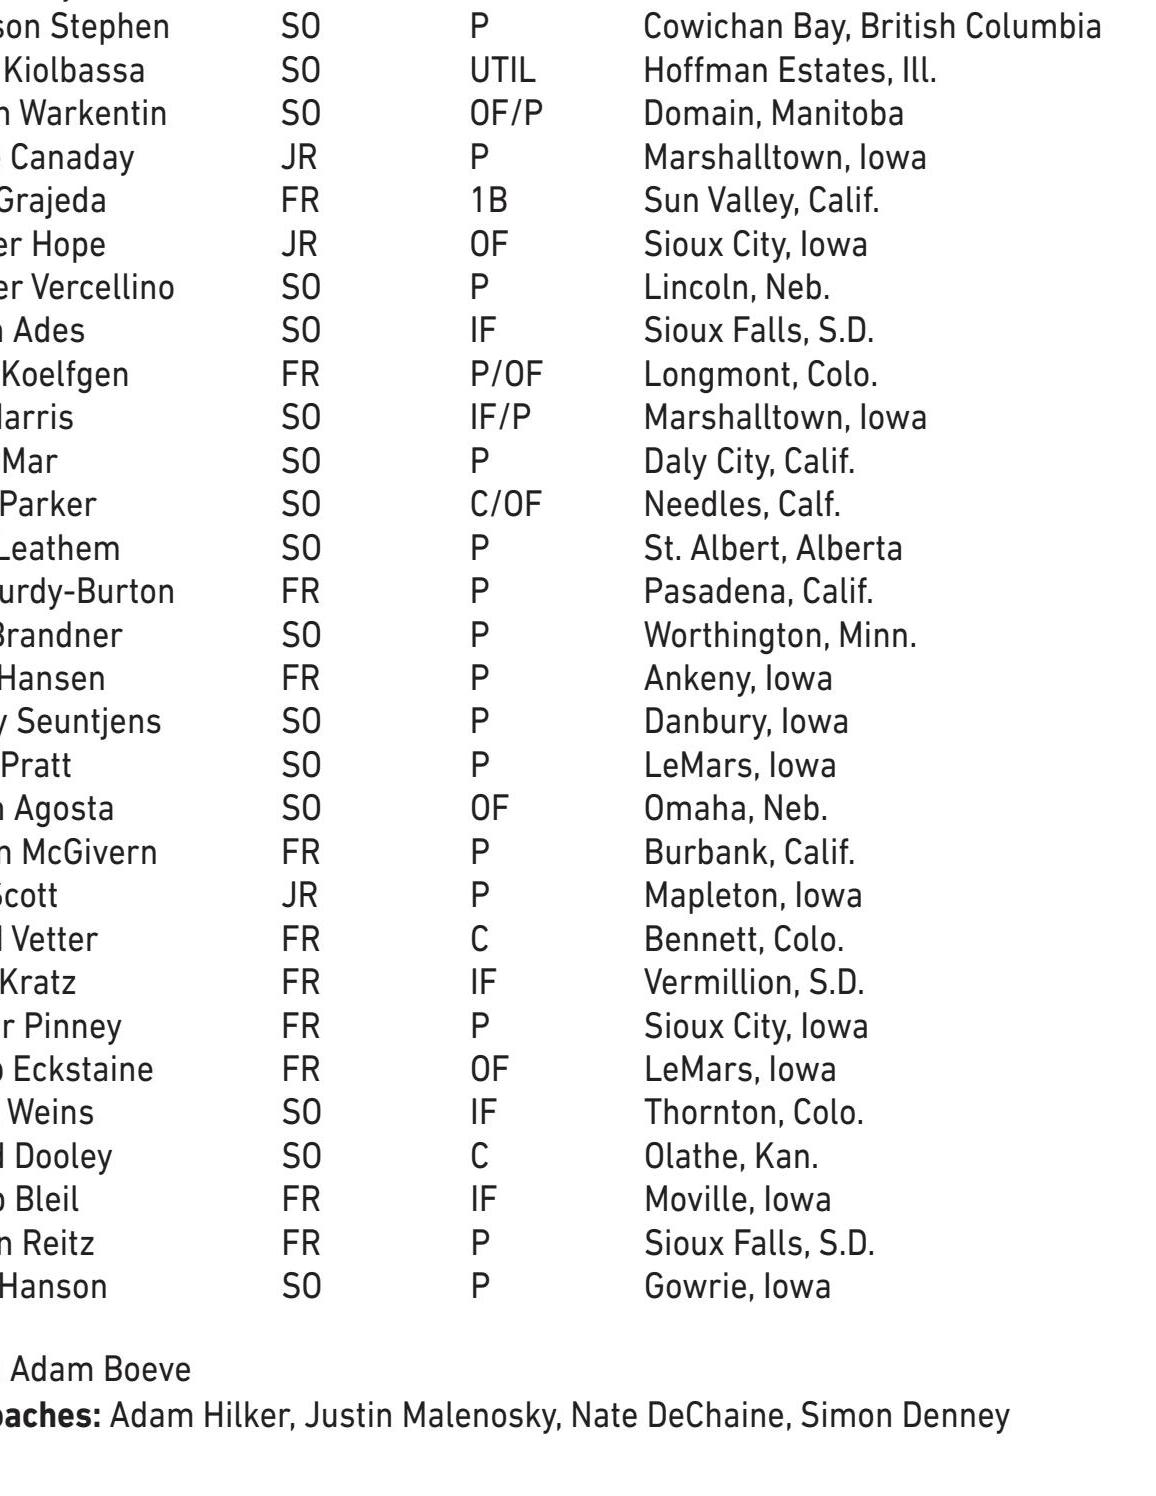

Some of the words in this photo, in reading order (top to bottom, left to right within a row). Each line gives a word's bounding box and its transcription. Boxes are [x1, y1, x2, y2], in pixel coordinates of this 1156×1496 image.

[51, 11, 169, 46] Stephen
[281, 11, 320, 39] SO
[471, 11, 489, 39] P
[644, 11, 783, 39] Cowichan
[794, 11, 851, 46] Bay,
[861, 11, 955, 40] British
[966, 11, 1101, 40] Columbia
[11, 142, 135, 177] Canaday
[280, 142, 317, 170] JR
[471, 142, 489, 170] P
[645, 142, 850, 174] Marshalltown,
[860, 142, 926, 170] Iowa
[30, 272, 174, 300] Vercellino
[282, 272, 321, 300] SO
[471, 272, 489, 300] P
[645, 272, 756, 304] Lincoln,
[766, 272, 829, 301] Neb.
[2, 359, 128, 394] Koelfgen
[282, 359, 320, 387] FR
[471, 359, 543, 387] P/OF
[645, 359, 798, 394] Longmont,
[808, 359, 877, 387] Colo.
[282, 533, 321, 561] SO
[471, 533, 489, 561] P
[644, 533, 681, 561] St.
[690, 533, 787, 565] Albert,
[796, 533, 902, 561] Alberta
[283, 663, 320, 691] FR
[471, 663, 489, 691] P
[643, 663, 756, 698] Ankeny,
[766, 663, 832, 691] Iowa
[13, 793, 113, 828] Agosta
[282, 793, 321, 821] SO
[471, 793, 510, 821] OF
[645, 793, 754, 825] Omaha,
[764, 793, 827, 821] Neb.
[281, 880, 318, 908] JR
[472, 880, 490, 908] P
[645, 880, 786, 915] Mapleton,
[796, 880, 862, 908] Iowa
[0, 967, 76, 995] Kratz
[283, 967, 320, 995] FR
[472, 967, 497, 995] IF
[643, 967, 800, 999] Vermillion,
[809, 967, 864, 995] S.D.
[7, 1097, 94, 1125] Weins
[282, 1097, 321, 1126] SO
[472, 1097, 498, 1125] IF
[644, 1097, 784, 1129] Thornton,
[794, 1097, 863, 1125] Colo.
[0, 1271, 107, 1299] Hanson
[282, 1271, 321, 1299] SO
[472, 1271, 490, 1299] P
[645, 1271, 754, 1303] Gowrie,
[765, 1271, 830, 1299] Iowa
[10, 1354, 93, 1383] Adam
[105, 1354, 191, 1382] Boeve
[109, 1400, 193, 1429] Adam
[204, 1400, 295, 1432] Hilker,
[304, 1400, 392, 1428] Justin
[403, 1400, 562, 1435] Malenosky,
[572, 1400, 638, 1428] Nate
[648, 1400, 791, 1432] DeChaine,
[801, 1400, 892, 1428] Simon
[903, 1400, 1011, 1435] Denney
